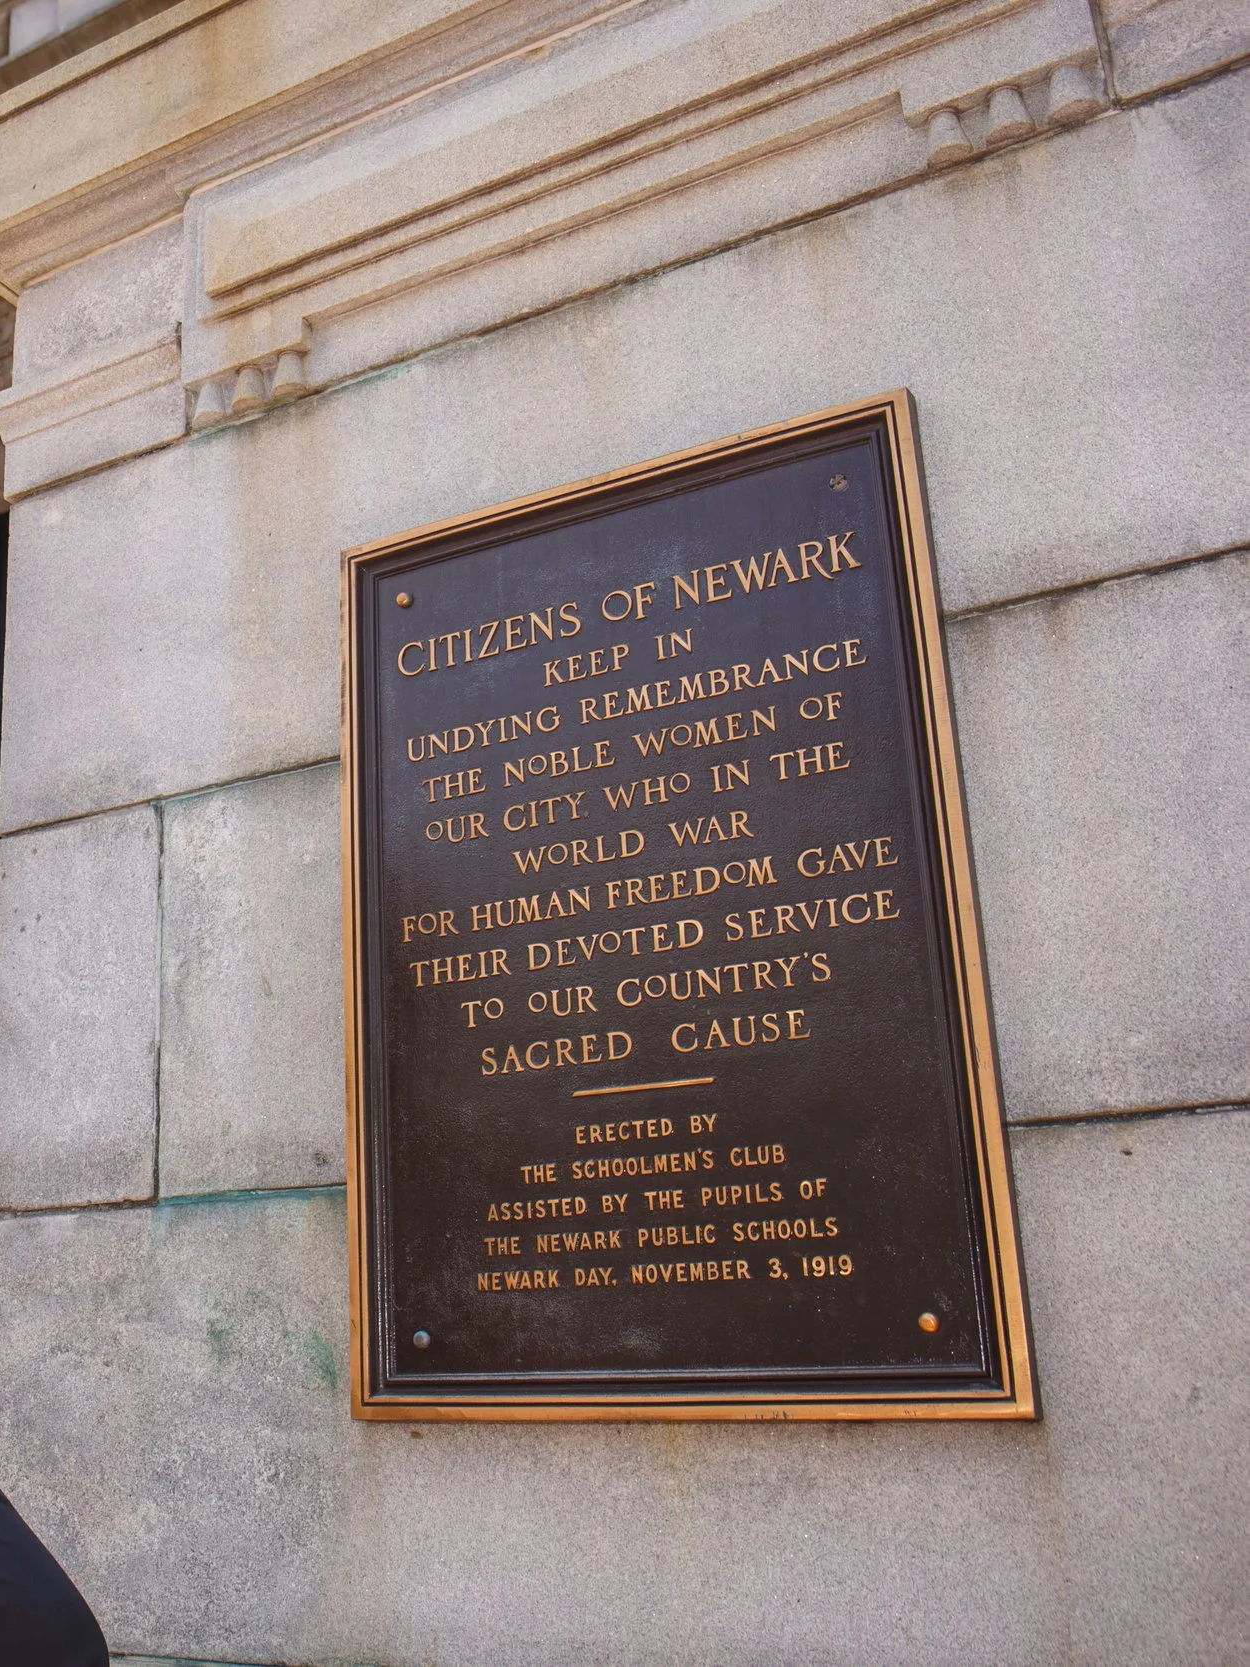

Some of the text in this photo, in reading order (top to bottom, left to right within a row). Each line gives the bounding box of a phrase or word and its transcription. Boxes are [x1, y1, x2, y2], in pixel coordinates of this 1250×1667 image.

[398, 532, 861, 676] CITIZENS OF NEWARK
[543, 629, 694, 687] KEEP IN
[407, 639, 867, 762] UNDYING REMEMBRANCE
[422, 692, 844, 803] THE NOBLE WOMEN OF
[425, 742, 851, 843] OUR CITY WHO IN THE
[513, 810, 754, 875] WORLD WAR
[402, 837, 899, 943] FOR HUMAN FREEDOM GAVE
[410, 889, 901, 988] THEIR DEVOTED SERVICE
[461, 952, 832, 1028] TO OUR COUNTRY'S
[480, 1009, 812, 1076] SACRED CAUSE
[575, 1113, 718, 1145] ERECTED BY
[521, 1144, 786, 1185] THE SCHOOLMEN'S CLUB
[487, 1178, 828, 1222] ASSISTED BY THE PUPILS OF
[484, 1218, 839, 1256] THE NEWARK PUBLIC SCHOOLS
[477, 1254, 853, 1293] NEWARK DAY, NOVEMBER 3, 1919
